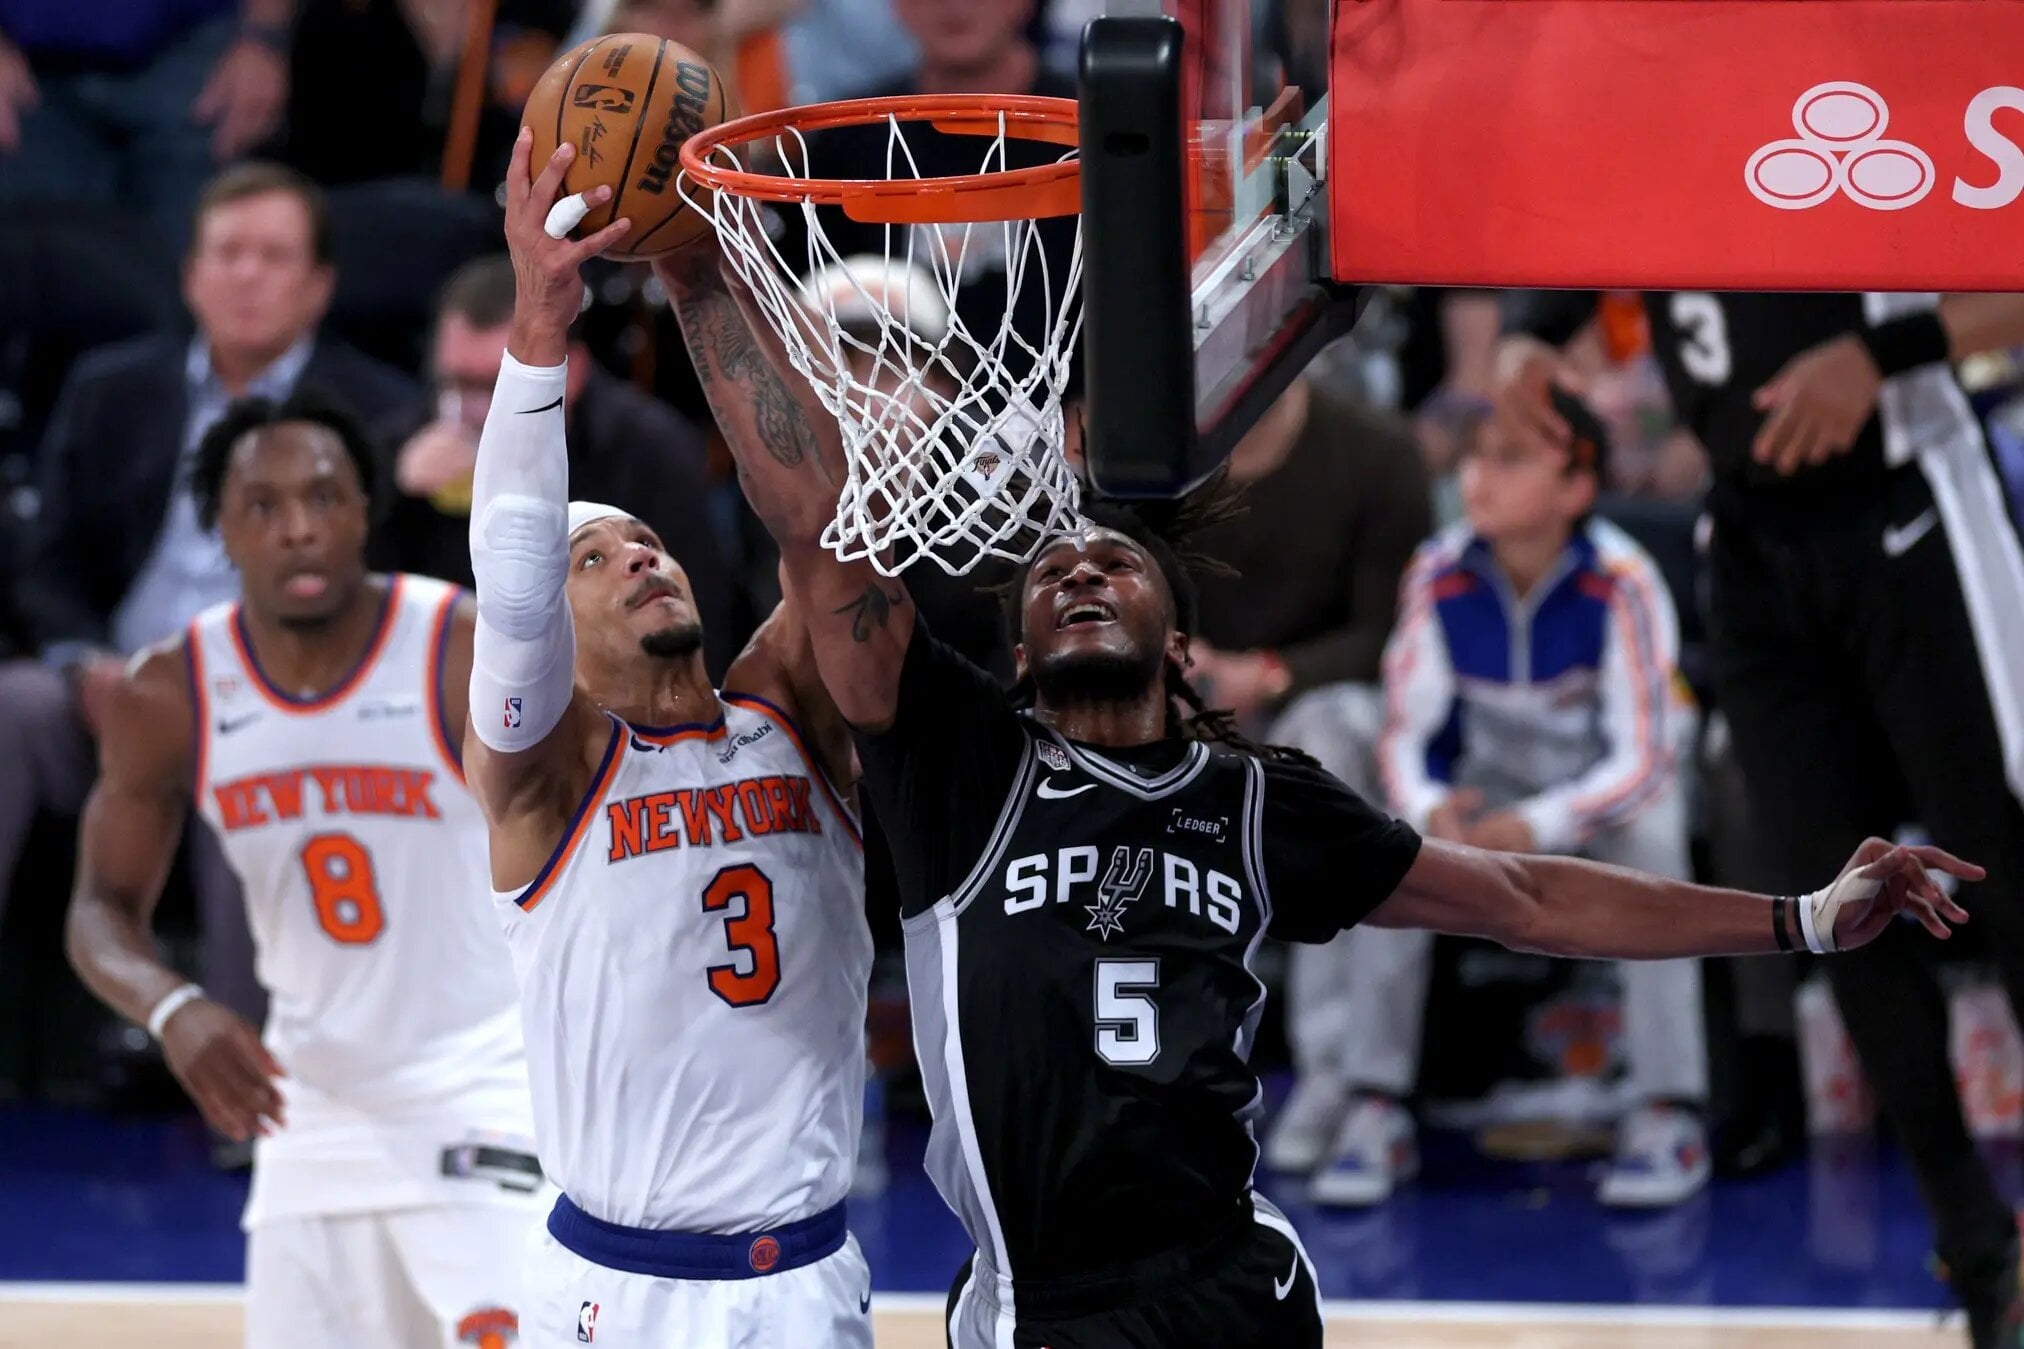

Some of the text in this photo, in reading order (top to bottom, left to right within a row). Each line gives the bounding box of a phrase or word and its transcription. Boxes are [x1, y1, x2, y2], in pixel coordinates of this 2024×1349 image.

[1670, 291, 1730, 386] 3
[306, 765, 441, 821] YORK
[607, 774, 822, 864] NEW YORK
[1176, 815, 1221, 835] LEDGER
[301, 831, 386, 945] 8
[701, 862, 782, 1009] 3
[1004, 845, 1242, 942] SPURS
[1093, 956, 1161, 1066] 5
